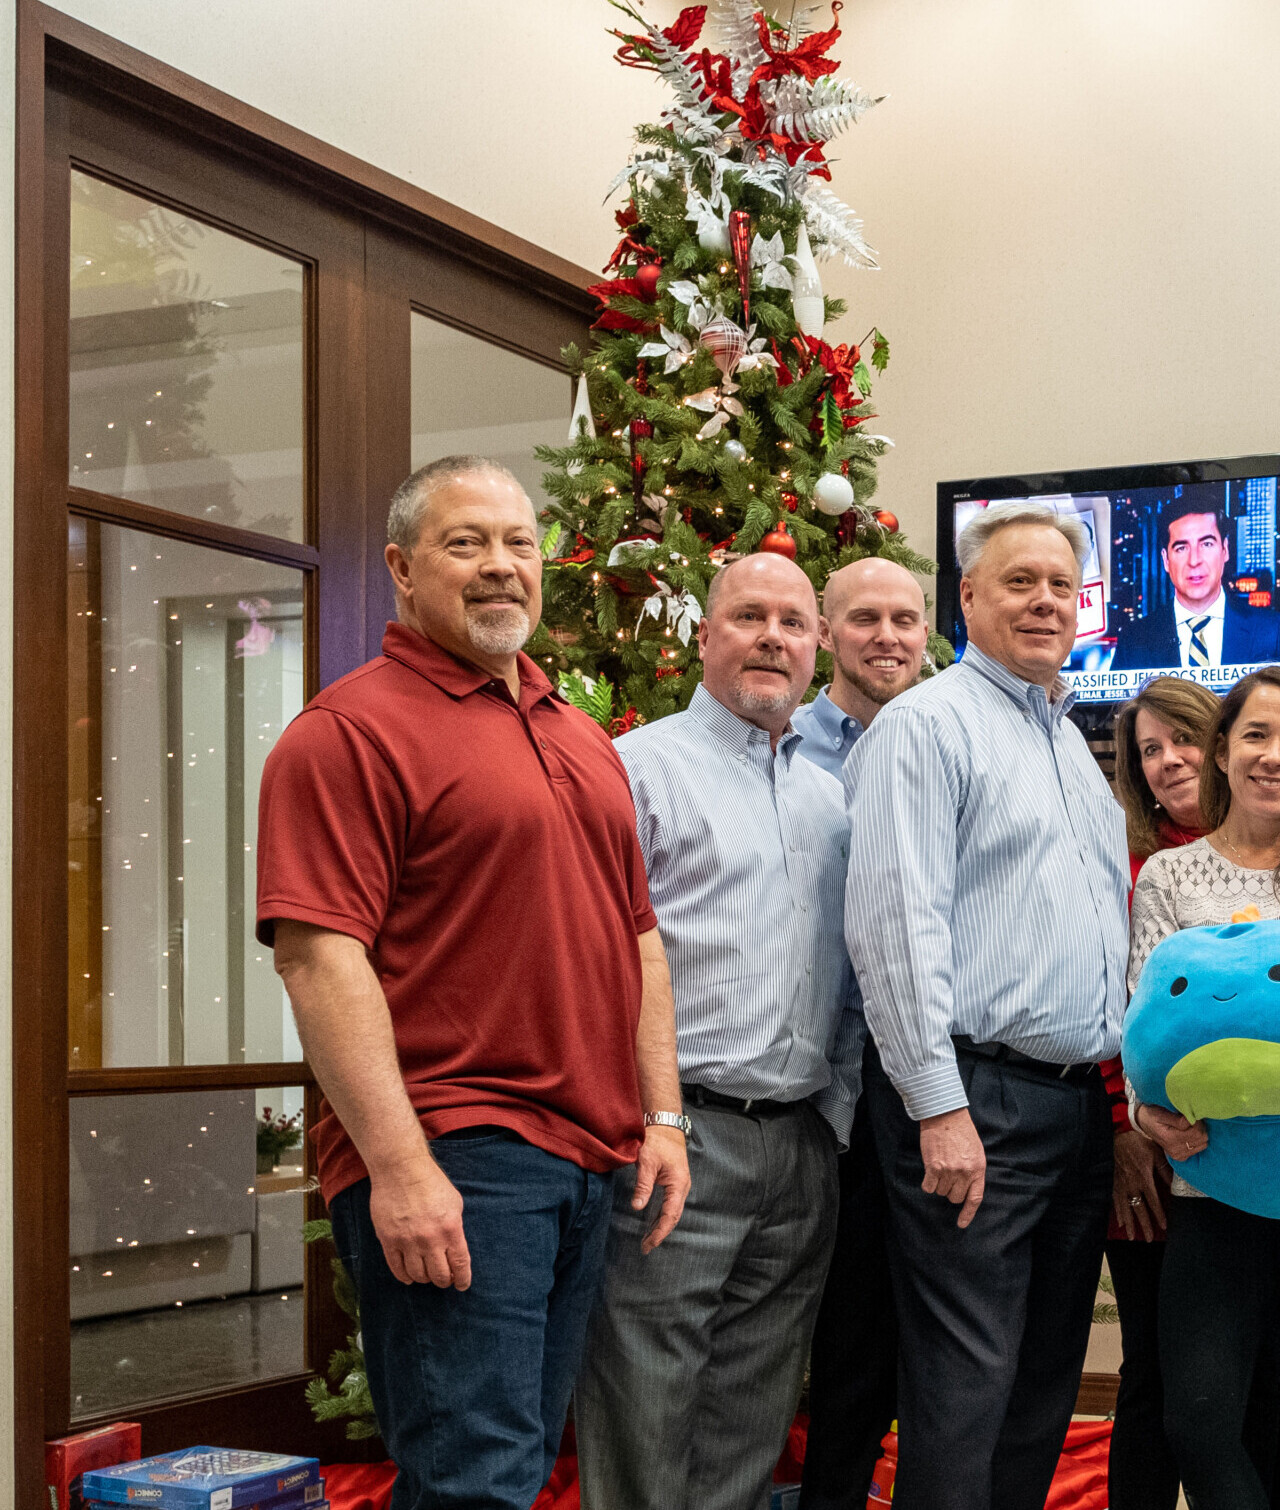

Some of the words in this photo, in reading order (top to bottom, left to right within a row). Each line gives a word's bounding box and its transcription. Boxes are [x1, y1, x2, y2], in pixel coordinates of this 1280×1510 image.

[1201, 666, 1257, 682] RELEASE
[1079, 690, 1102, 699] EMAIL
[284, 1470, 309, 1487] CONNECT
[134, 1488, 162, 1498] CONNECT
